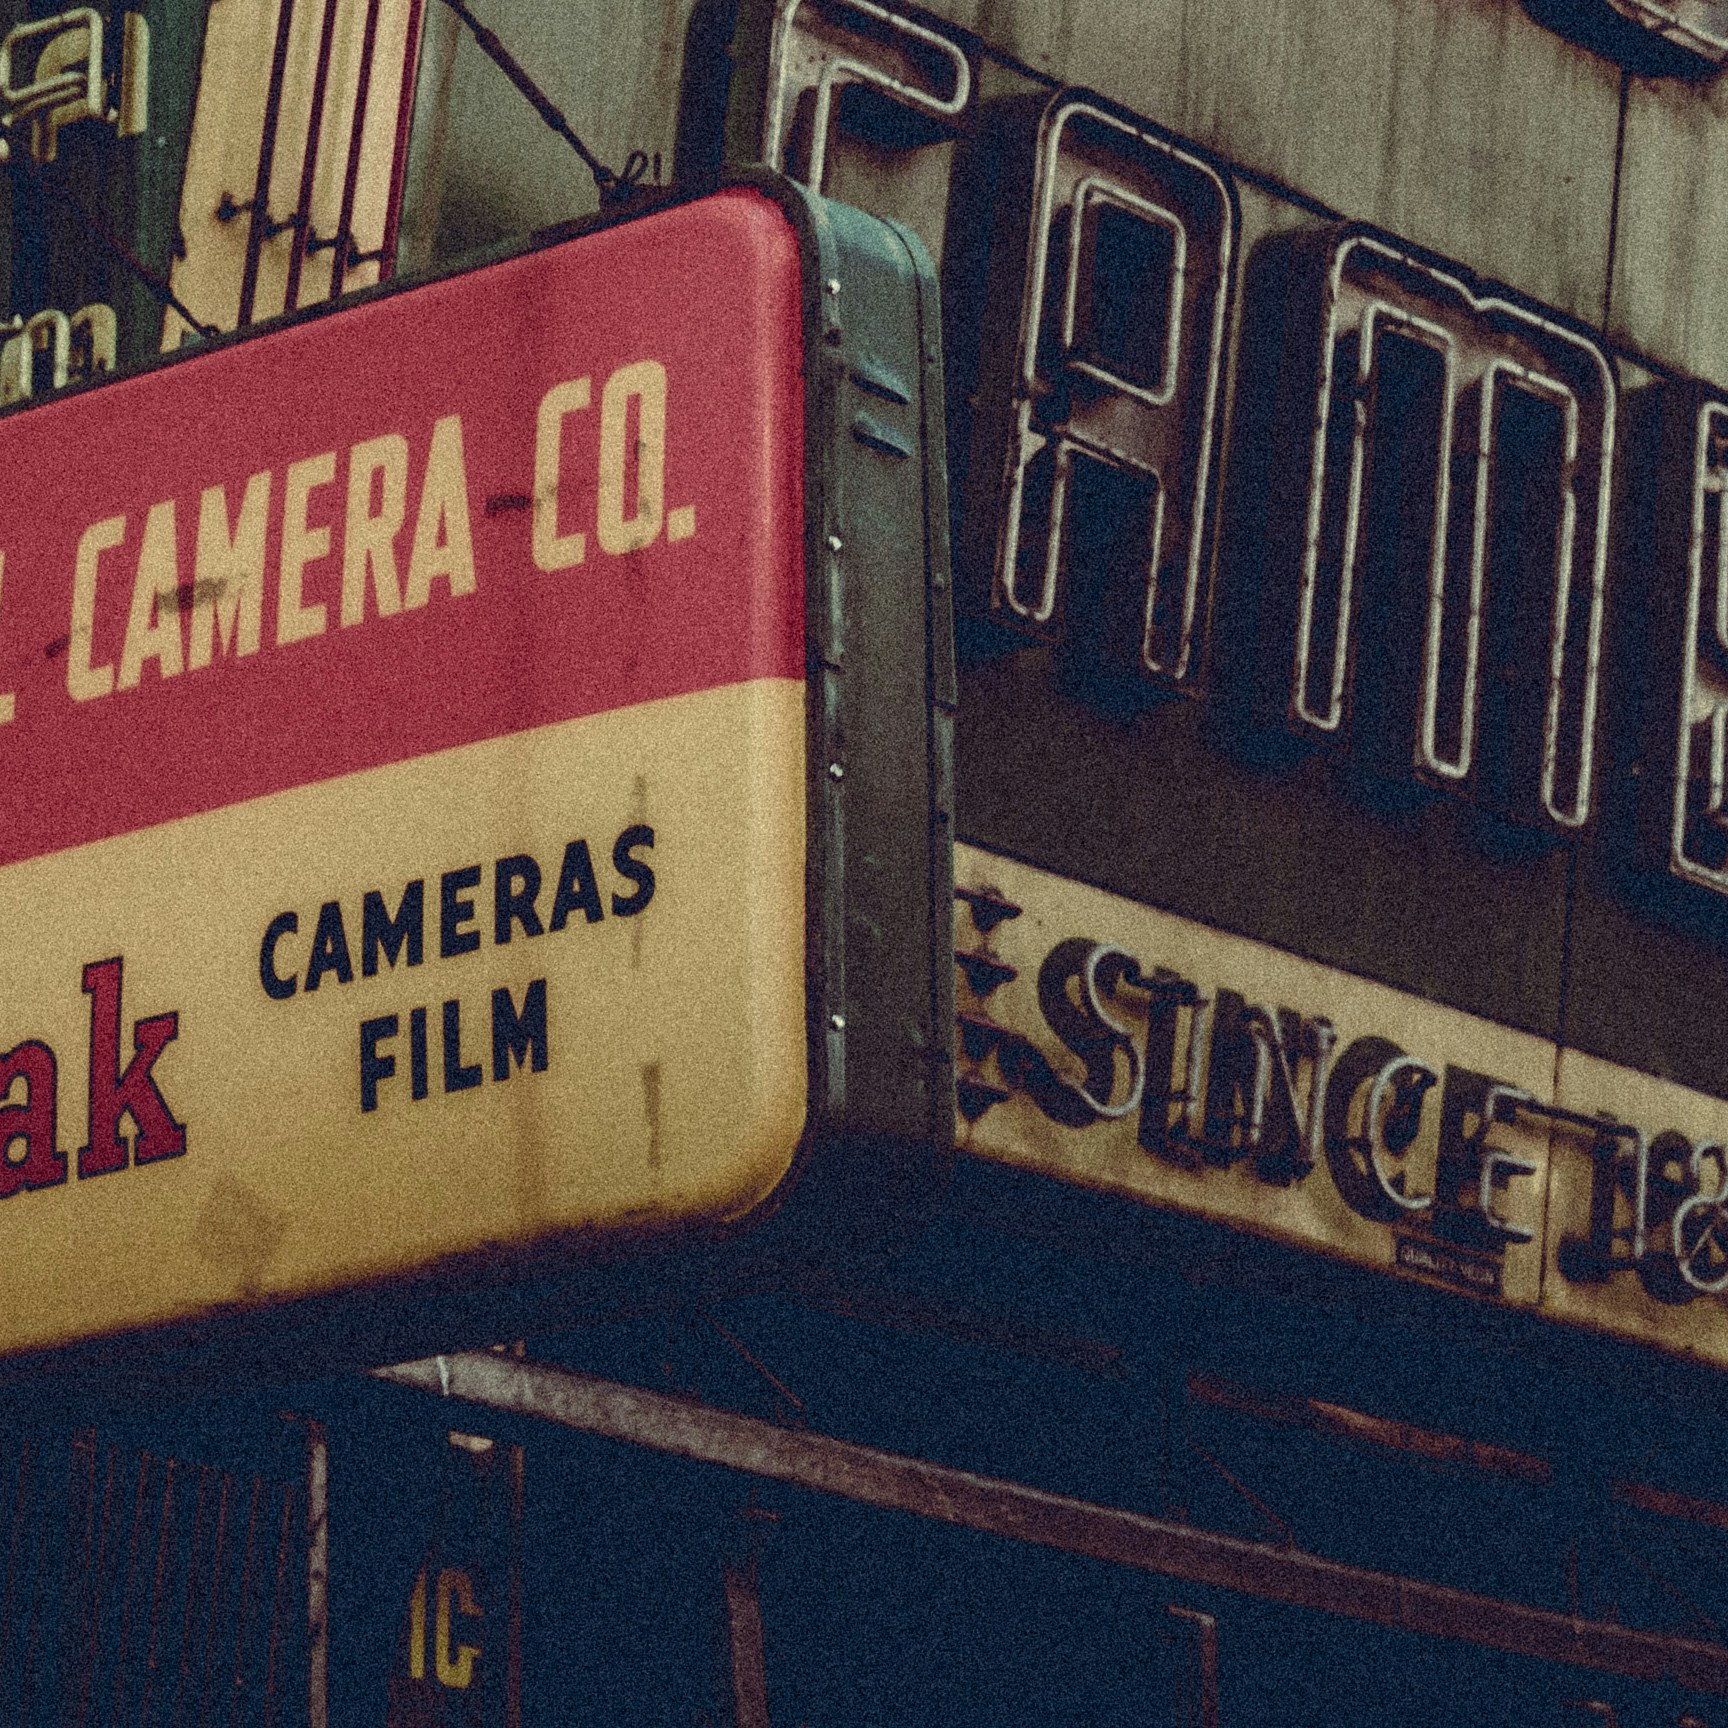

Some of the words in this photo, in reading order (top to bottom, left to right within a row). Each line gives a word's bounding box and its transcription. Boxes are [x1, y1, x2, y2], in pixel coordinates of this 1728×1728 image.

[67, 415, 475, 702] CAMERA
[532, 359, 696, 574] CO.
[258, 824, 657, 1001] CAMERAS
[359, 978, 550, 1113] FILM
[998, 937, 1537, 1244] SINCE
